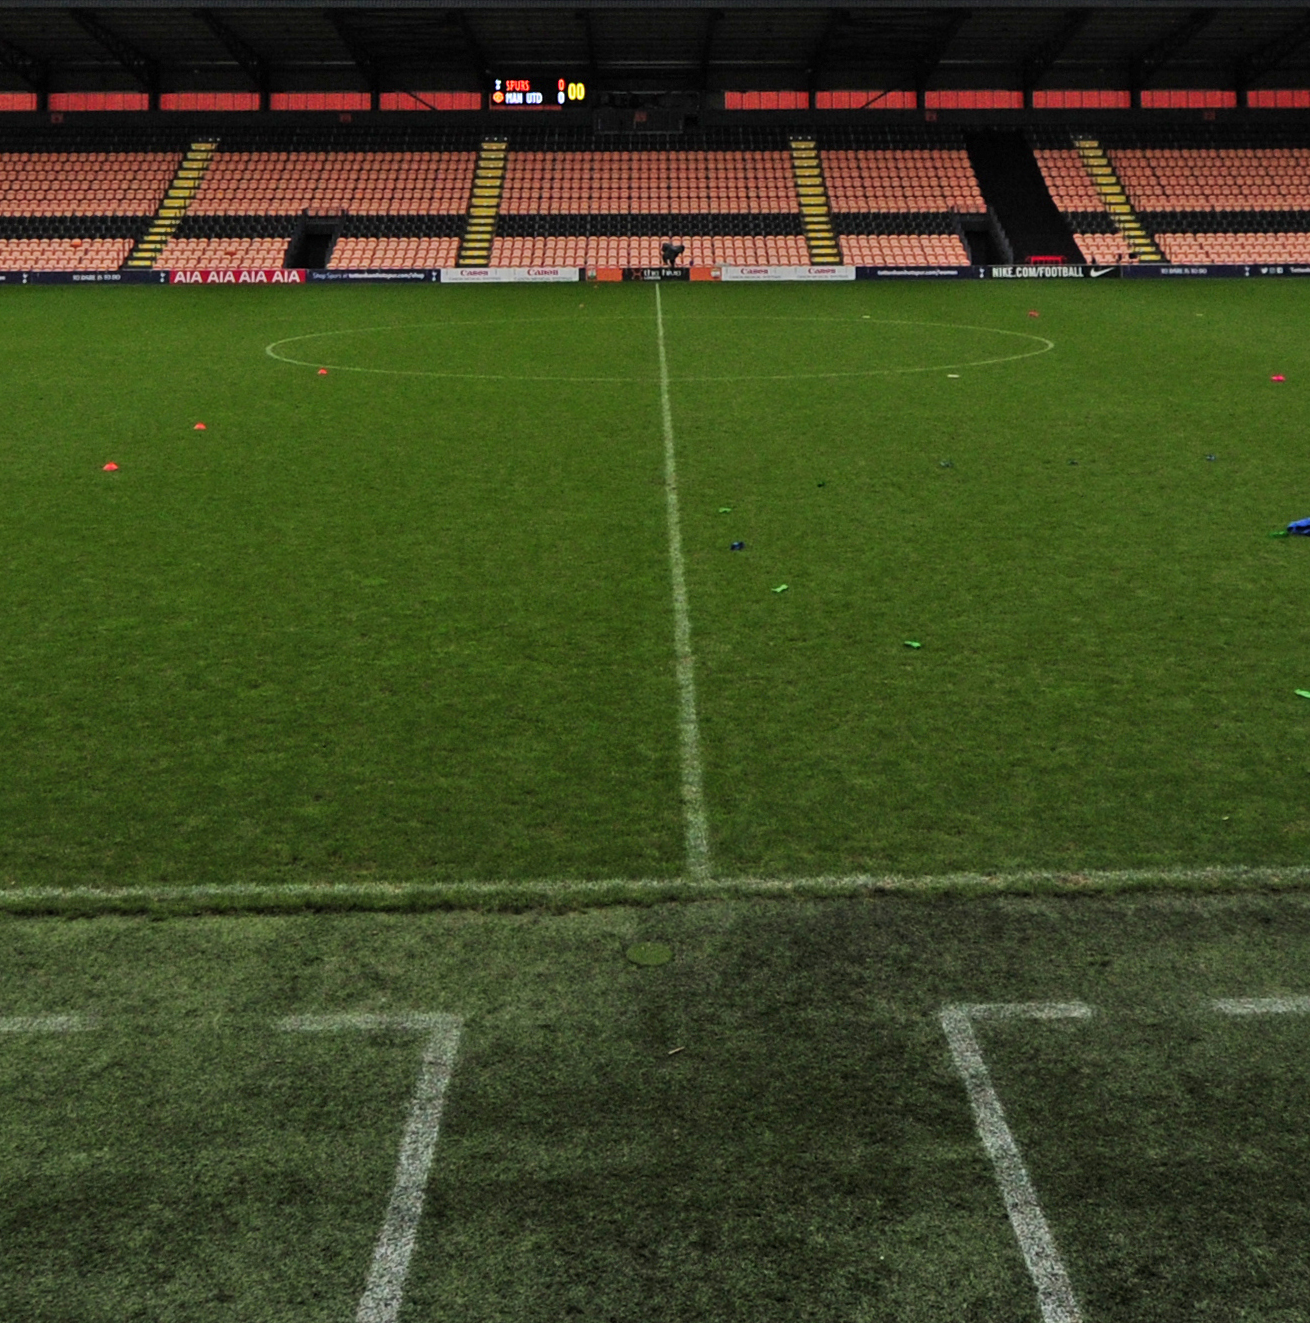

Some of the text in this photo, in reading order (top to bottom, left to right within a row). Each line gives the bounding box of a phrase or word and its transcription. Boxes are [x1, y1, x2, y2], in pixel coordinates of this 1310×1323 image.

[505, 78, 565, 91] SPURS 0
[568, 82, 586, 100] 00
[505, 91, 566, 105] MAN UTD 0
[174, 271, 203, 283] AIA
[207, 271, 236, 283] AIA
[238, 271, 267, 283] AIA
[272, 271, 301, 283] AIA
[992, 266, 1084, 278] NIKE.COM/FOOTBALL
